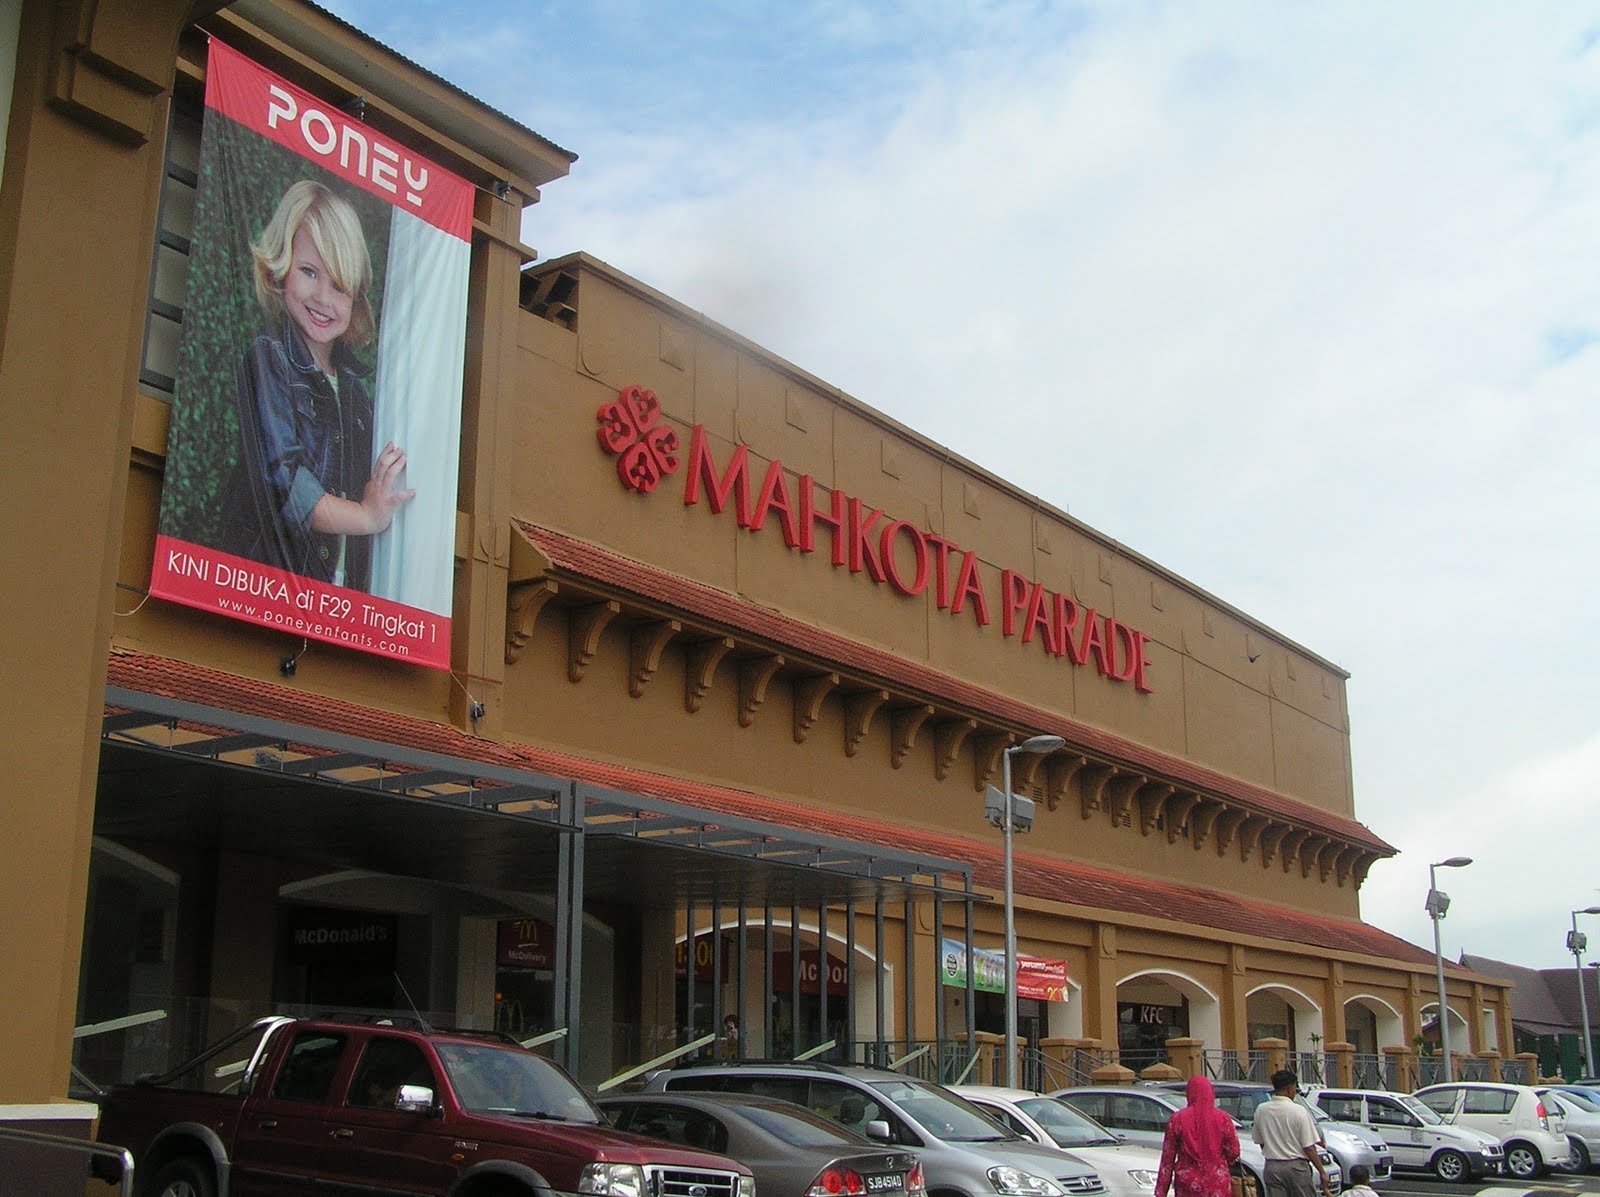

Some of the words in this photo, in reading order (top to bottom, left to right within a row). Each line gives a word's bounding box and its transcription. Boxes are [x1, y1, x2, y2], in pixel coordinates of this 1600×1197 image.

[268, 84, 428, 207] PONEY
[684, 424, 990, 625] MAHKOTA
[1003, 569, 1154, 693] PARADE
[167, 550, 210, 581] KINI
[215, 563, 290, 604] DIBUKA
[296, 589, 313, 611] di
[319, 594, 355, 623] F29,
[362, 605, 425, 640] Tingkat
[431, 623, 437, 643] 1
[218, 597, 410, 656] www.poneyenfants.com
[294, 924, 387, 945] McDonald's
[508, 950, 547, 964] McDelivery
[1140, 1005, 1163, 1024] KFC
